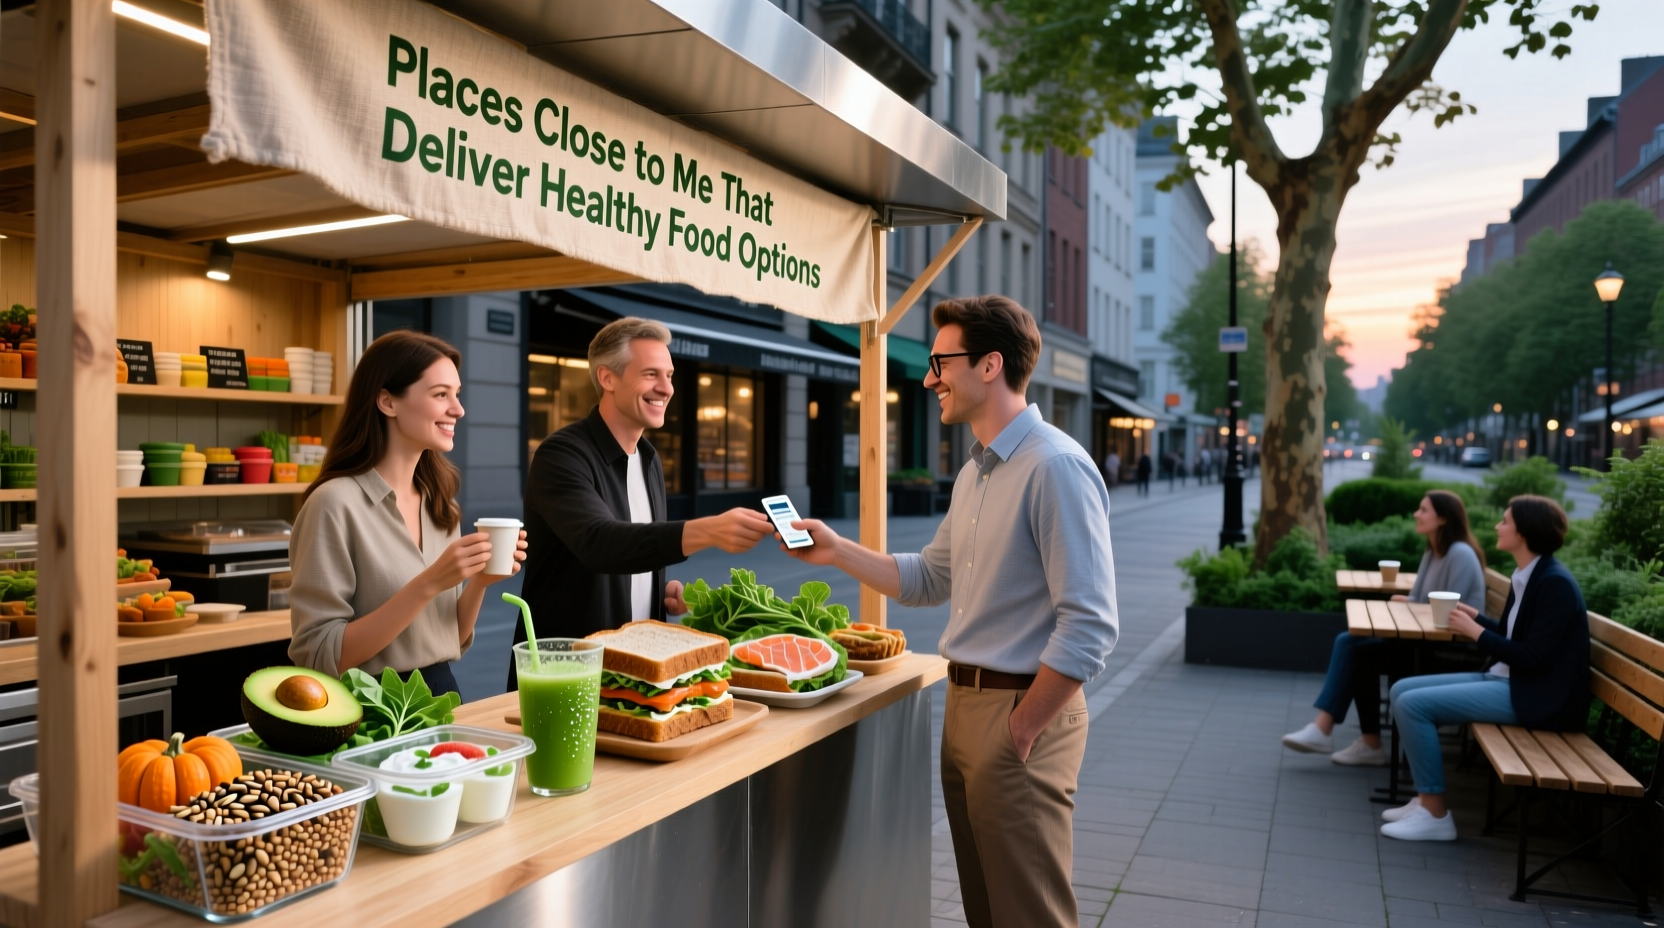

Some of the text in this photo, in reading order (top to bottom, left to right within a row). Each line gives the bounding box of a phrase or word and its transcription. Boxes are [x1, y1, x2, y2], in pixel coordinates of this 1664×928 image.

[381, 107, 821, 289] Deliver Healthy Food Options
[387, 34, 774, 226] Places Close to Me That
